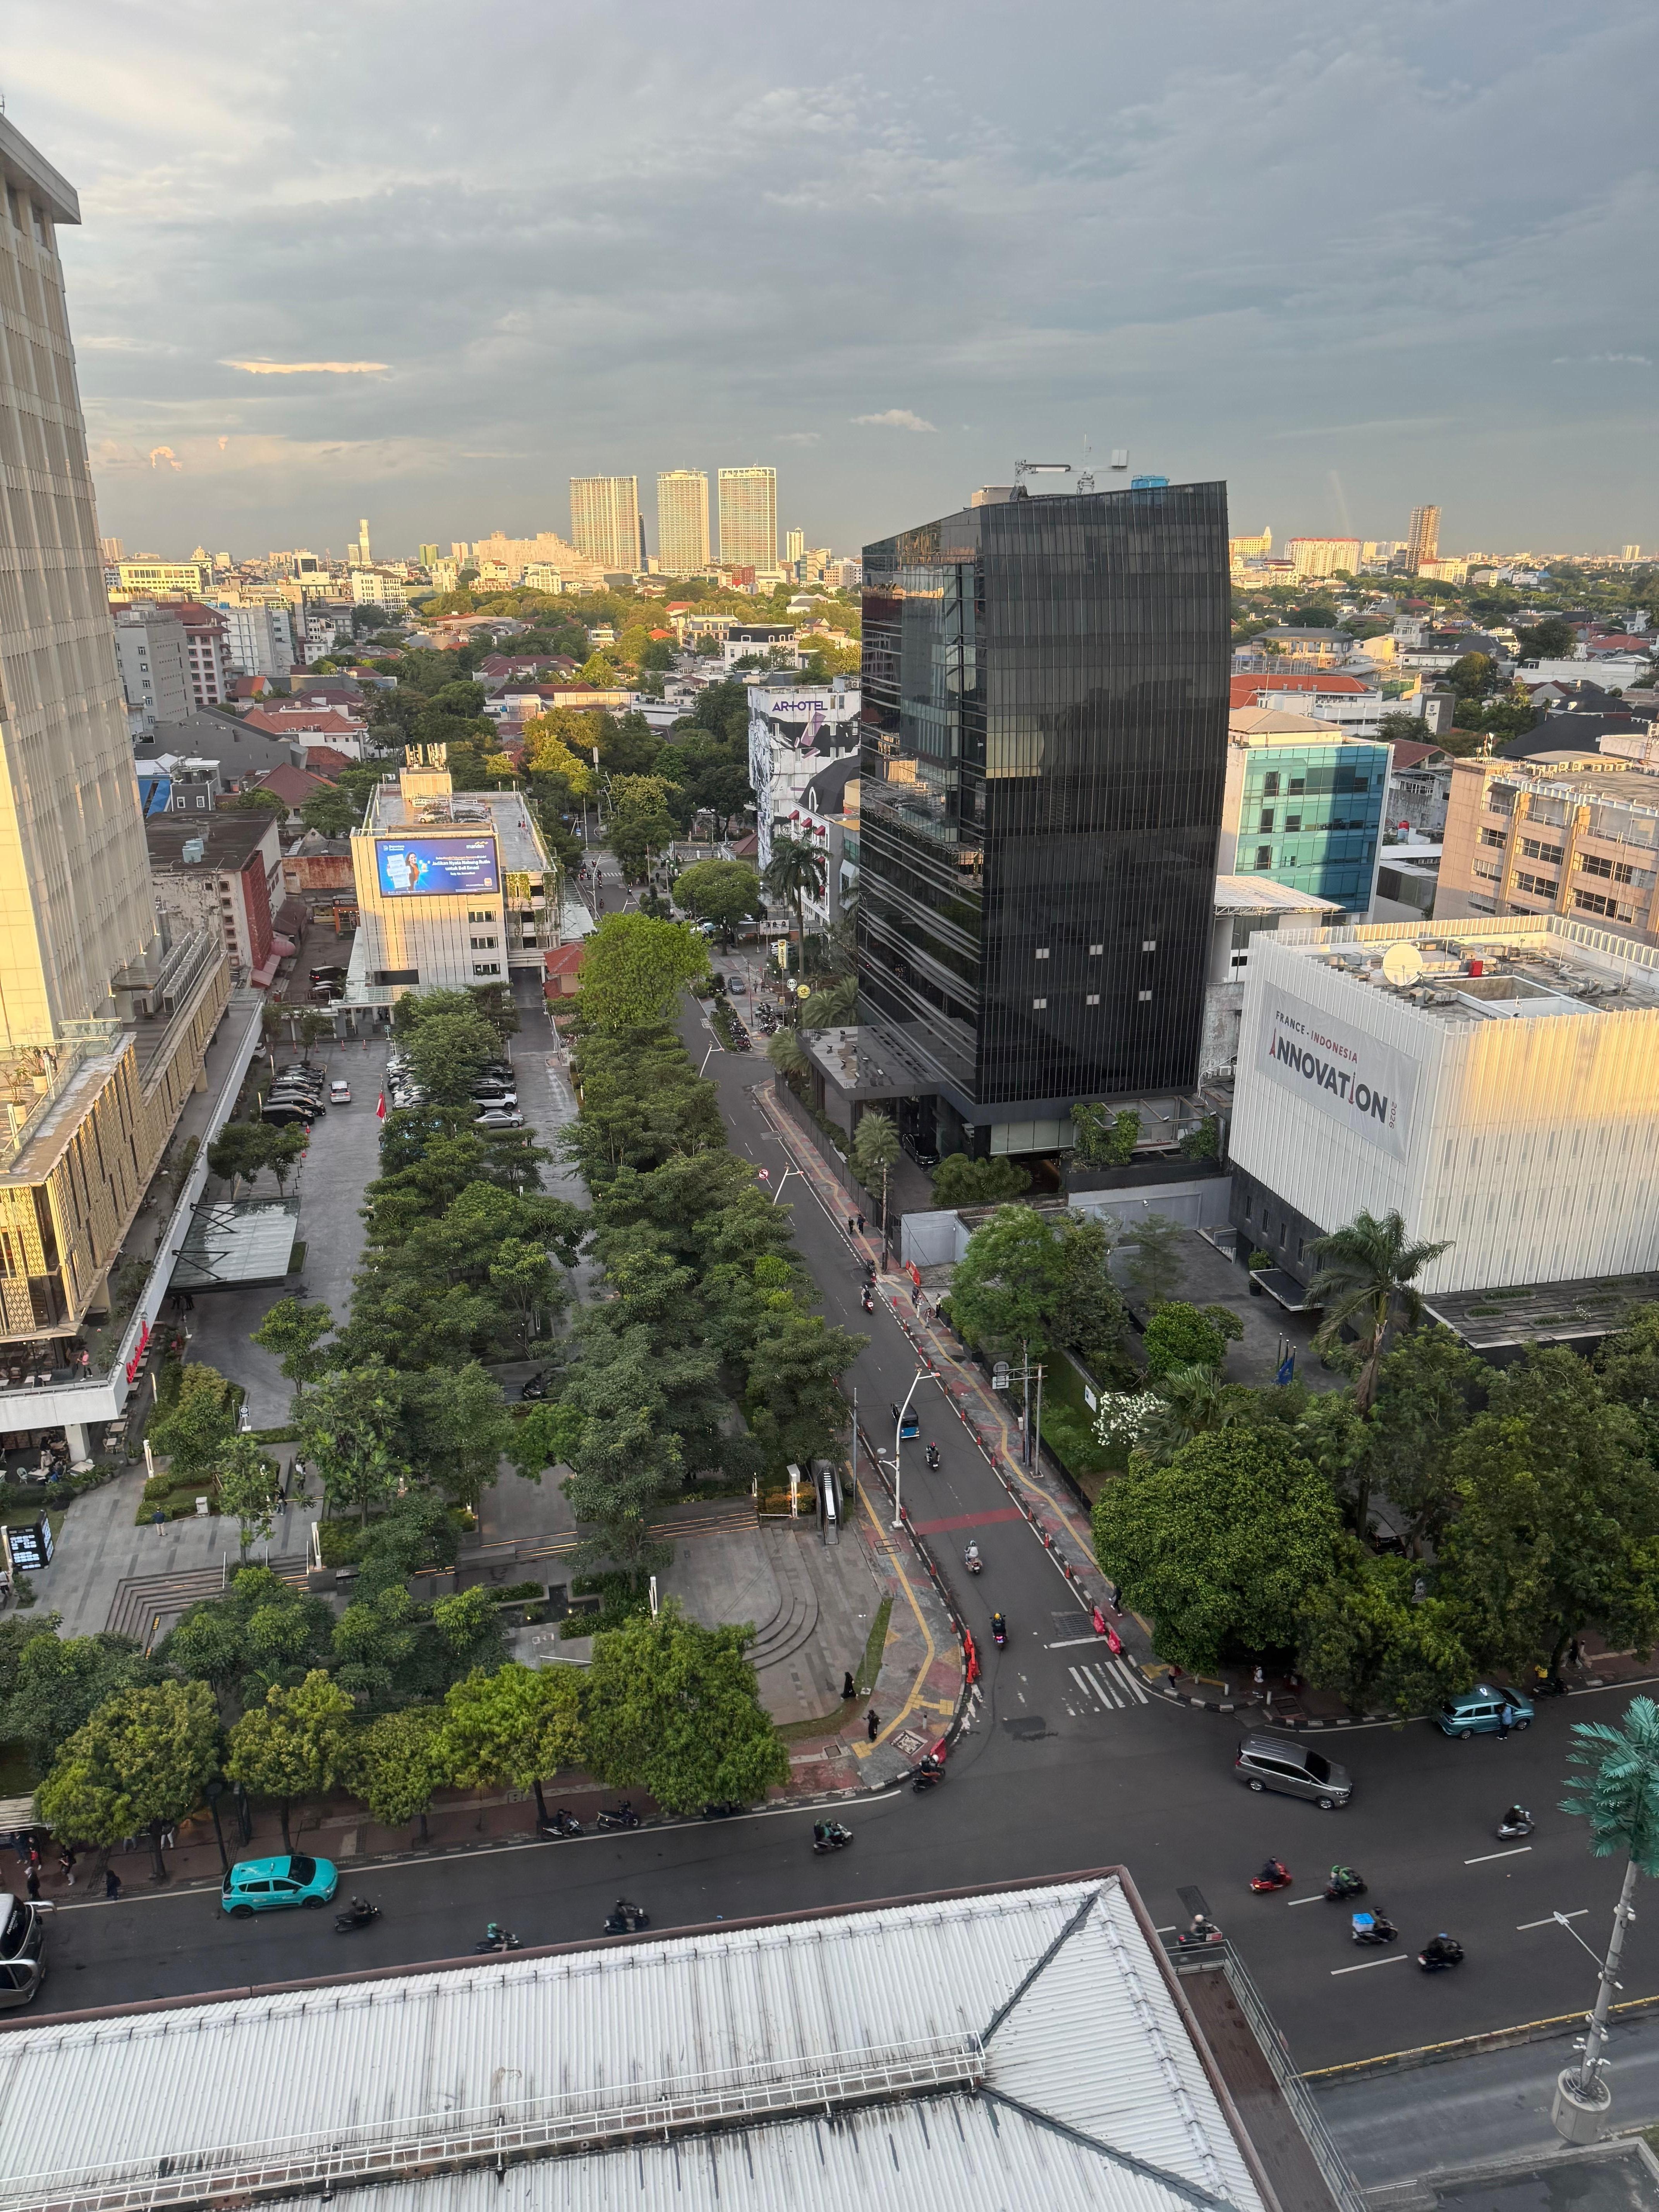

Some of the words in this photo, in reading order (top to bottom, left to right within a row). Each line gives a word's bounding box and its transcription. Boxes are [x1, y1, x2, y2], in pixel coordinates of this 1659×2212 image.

[1276, 1010, 1305, 1034] FRANCE
[1311, 1030, 1358, 1064] INDONESIA
[1269, 1027, 1388, 1124] INNOVATION
[1389, 1101, 1397, 1129] 2026
